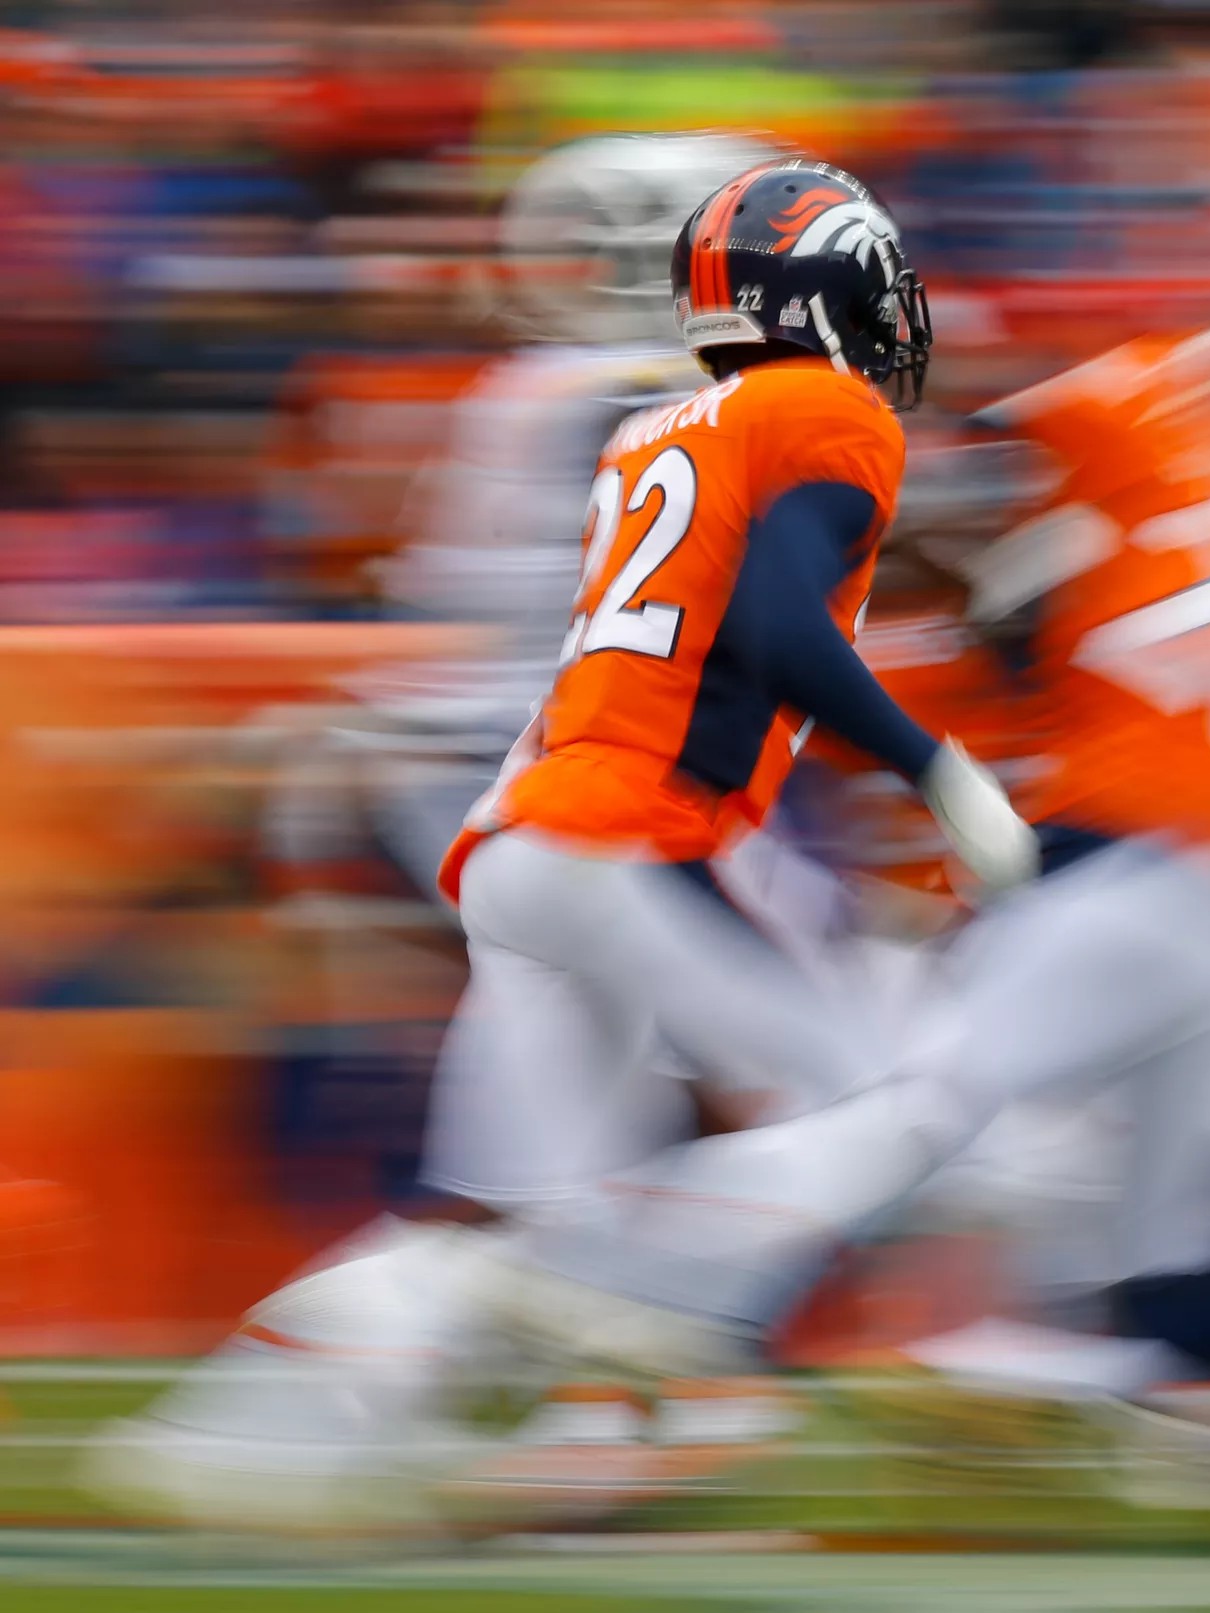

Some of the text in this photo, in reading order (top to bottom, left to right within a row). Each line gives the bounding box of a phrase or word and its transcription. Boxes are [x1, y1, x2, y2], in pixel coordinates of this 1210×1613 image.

[737, 284, 764, 311] 22
[687, 321, 740, 336] BRONCOS
[559, 445, 697, 664] 22
